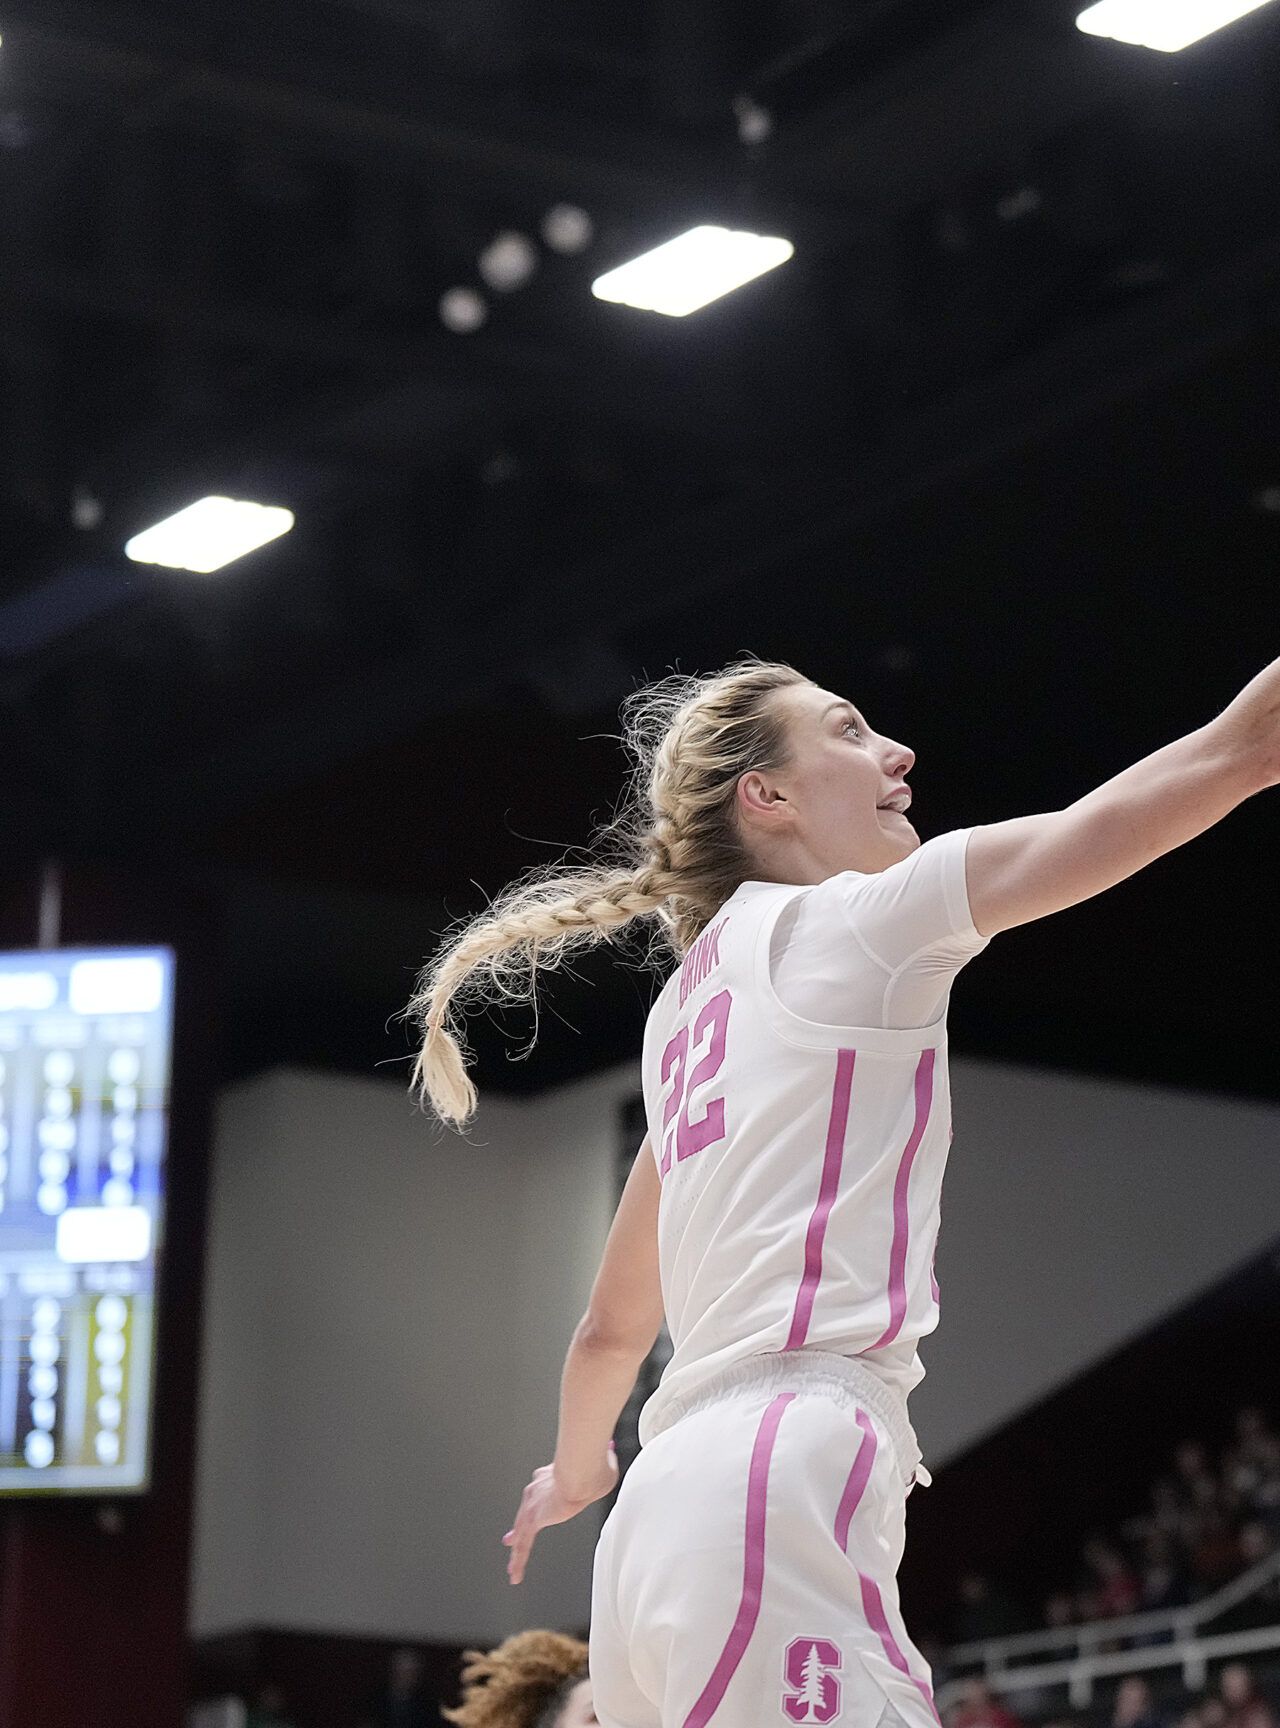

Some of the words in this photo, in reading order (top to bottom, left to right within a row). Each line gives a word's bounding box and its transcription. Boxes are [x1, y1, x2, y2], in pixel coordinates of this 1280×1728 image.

[679, 916, 730, 1010] BRINK
[660, 989, 733, 1183] 22
[781, 1635, 842, 1726] S
